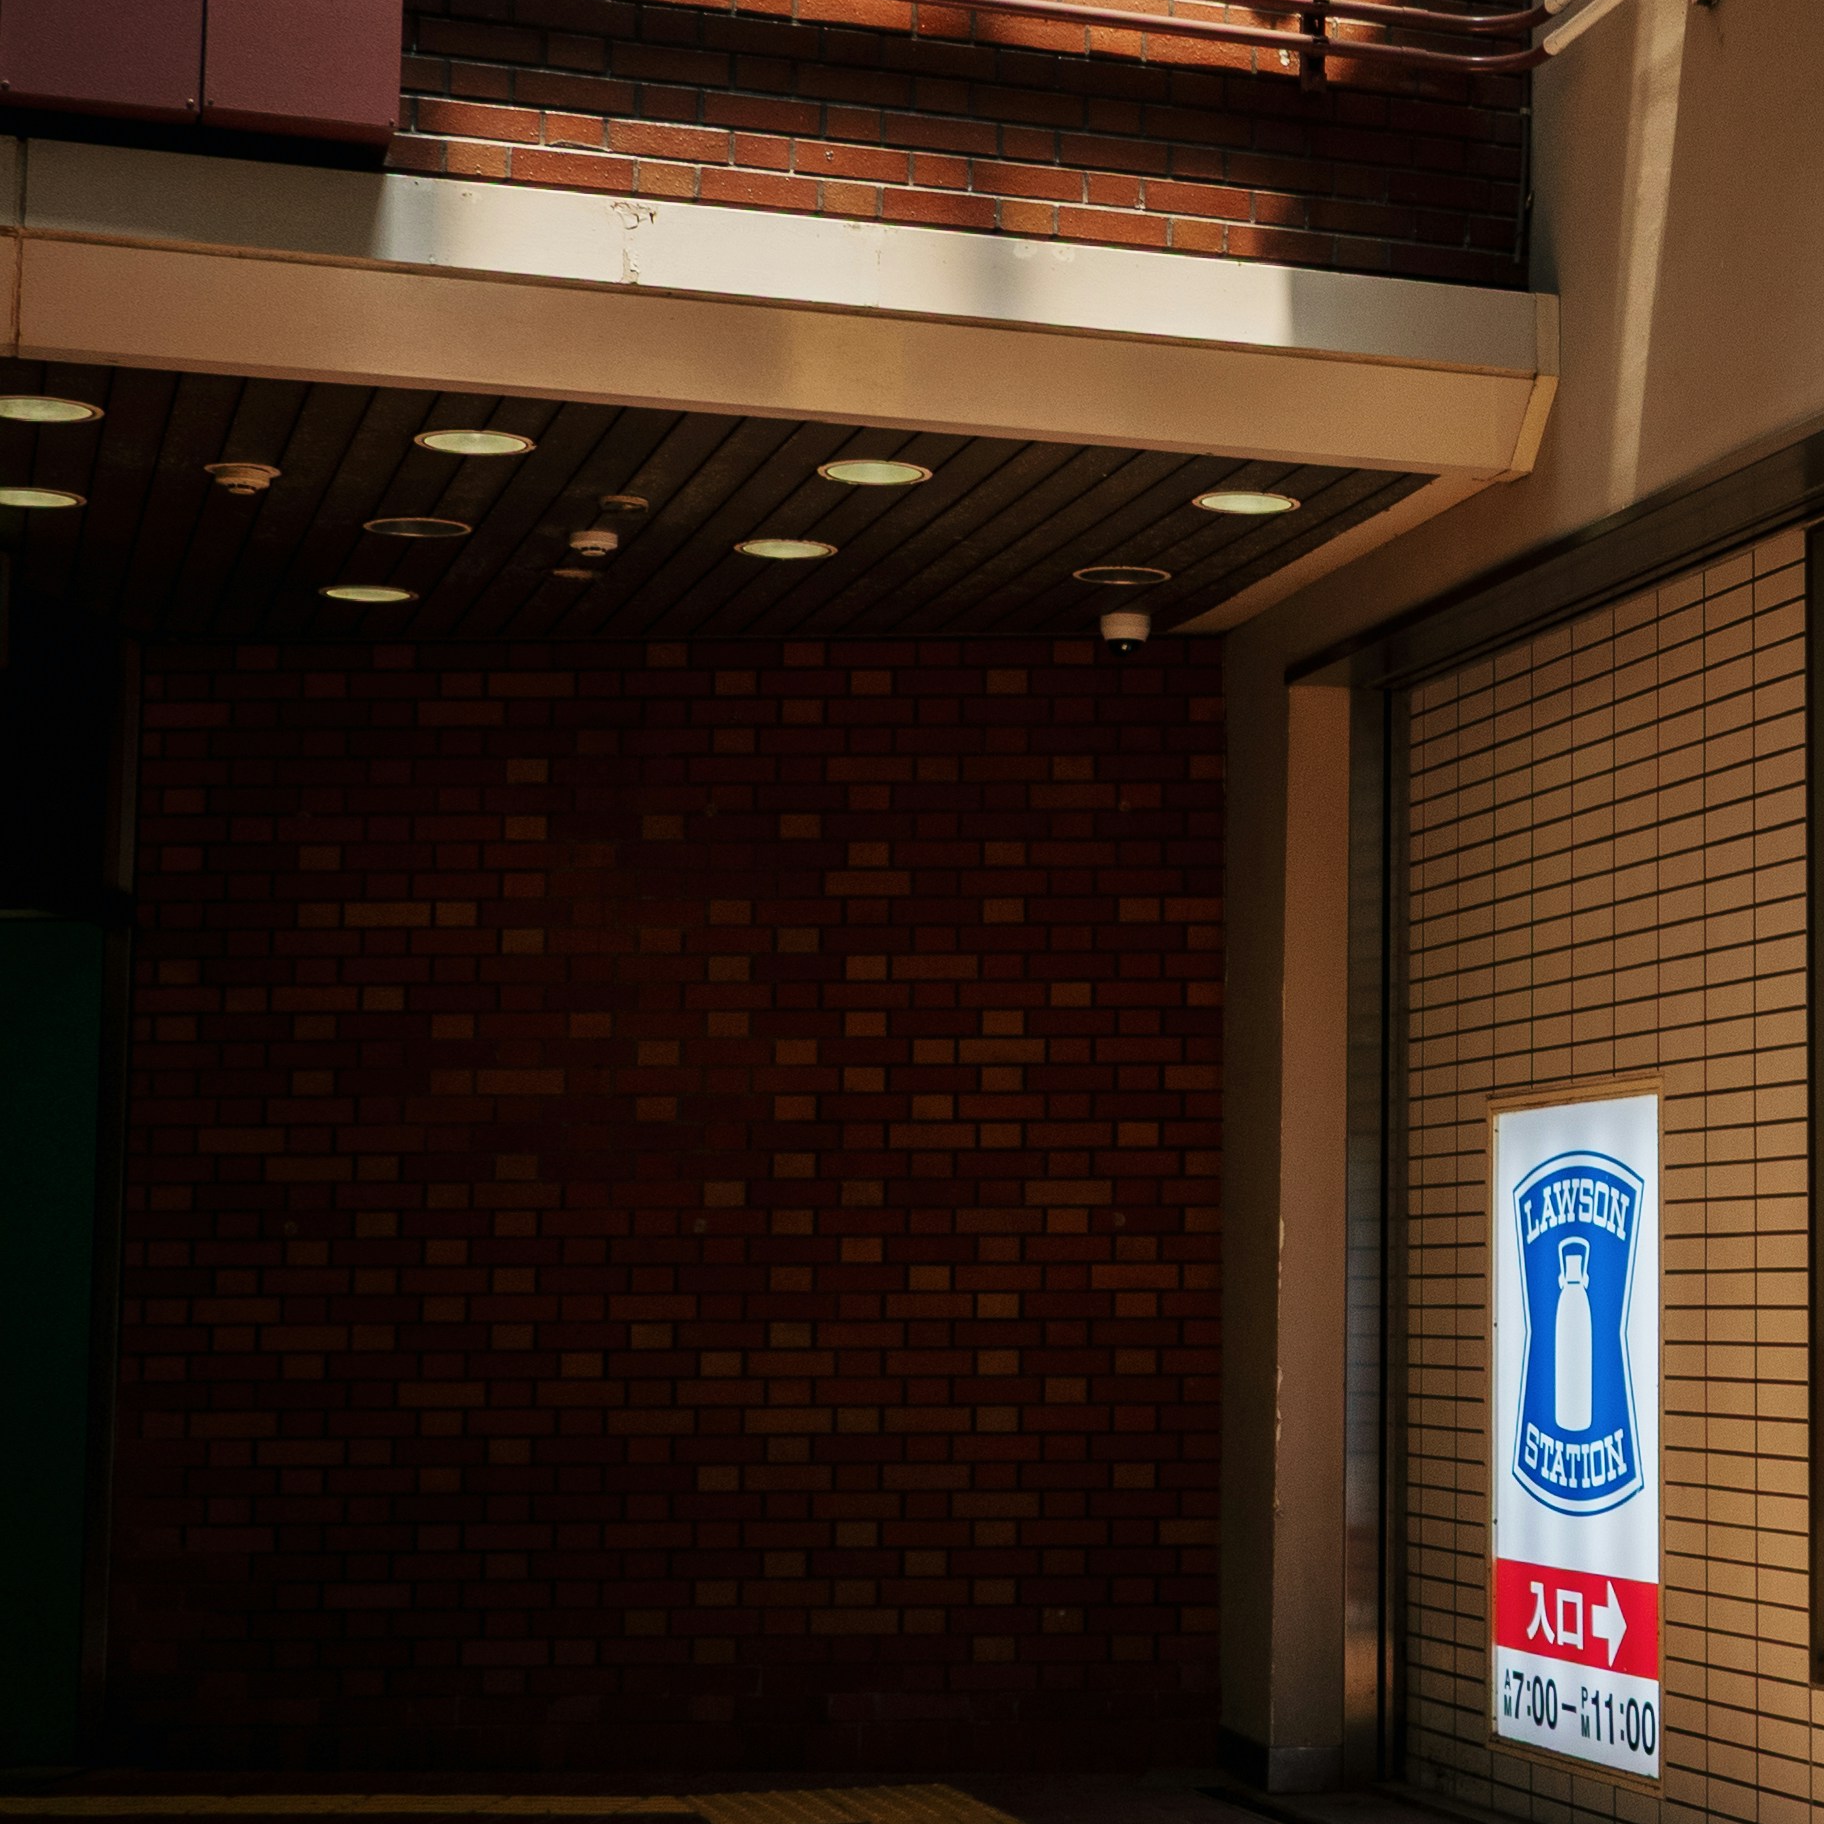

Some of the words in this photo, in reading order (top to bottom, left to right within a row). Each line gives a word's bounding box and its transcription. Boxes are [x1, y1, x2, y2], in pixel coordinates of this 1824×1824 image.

[1523, 1177, 1631, 1245] LAWSON
[1524, 1427, 1628, 1489] STATION
[1526, 1581, 1585, 1650] 入口
